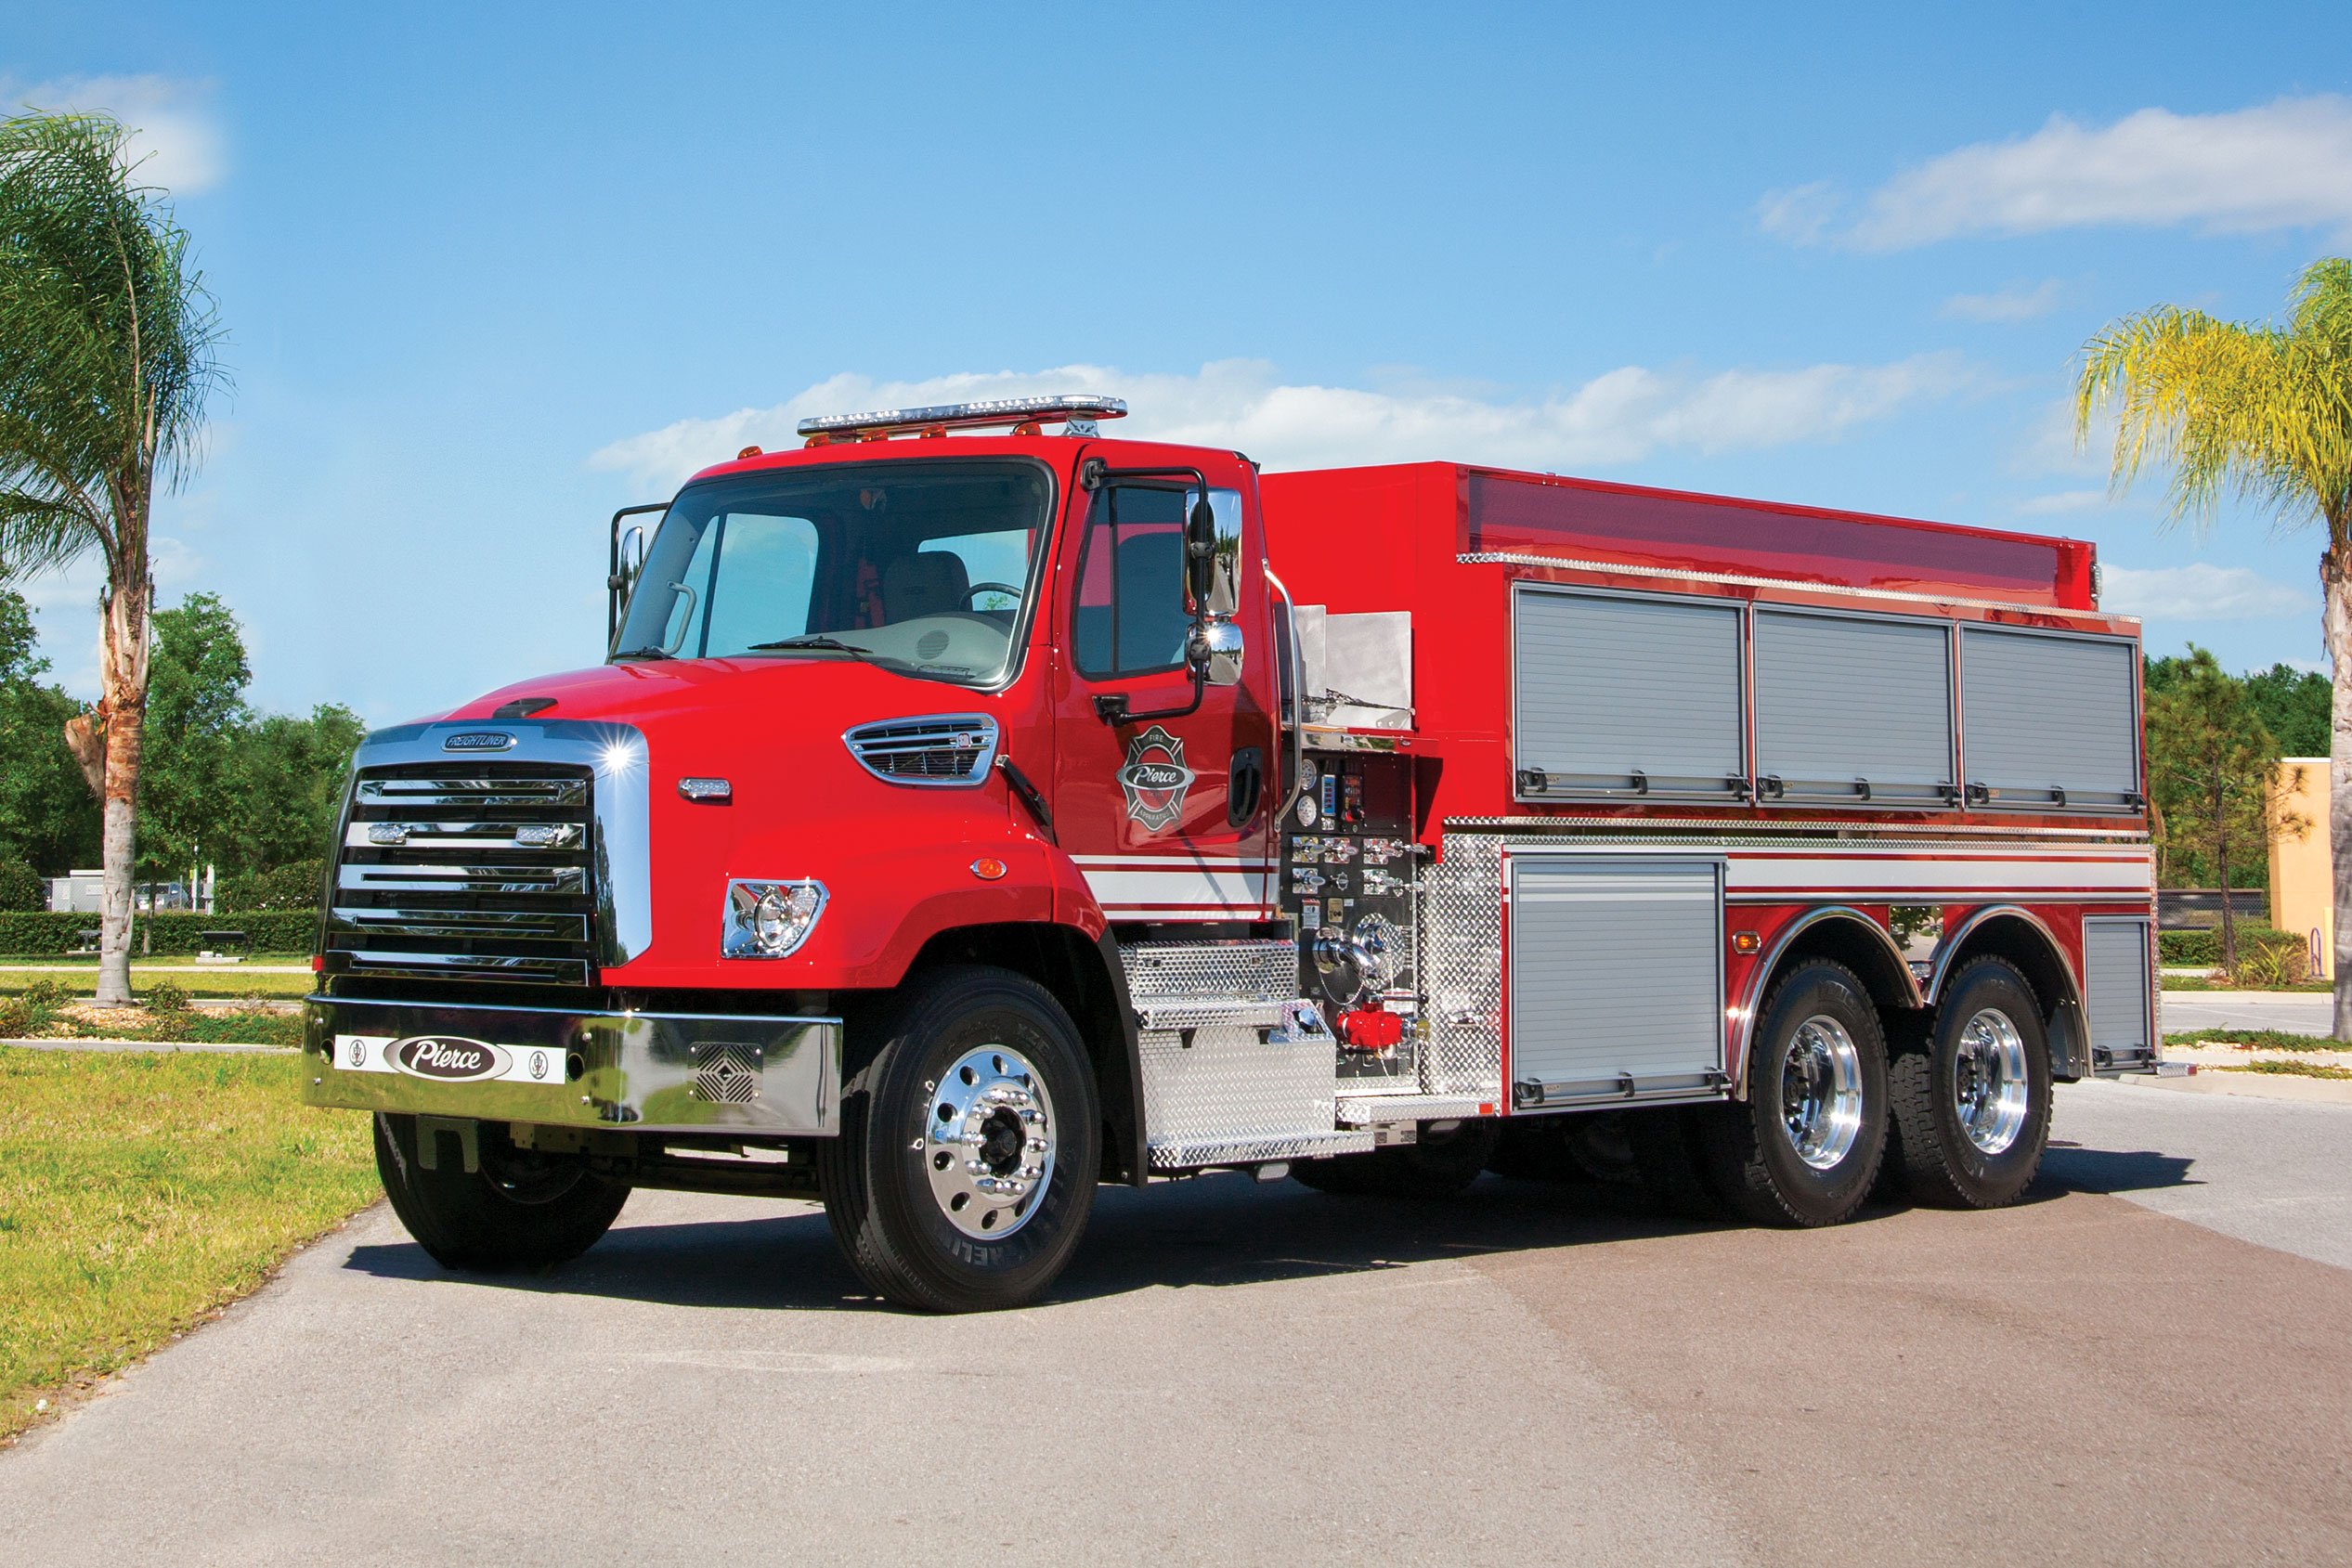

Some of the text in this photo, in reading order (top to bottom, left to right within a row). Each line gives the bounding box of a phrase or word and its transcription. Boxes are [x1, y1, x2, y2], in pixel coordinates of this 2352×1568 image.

[448, 735, 506, 746] FREIGHTLINER
[1149, 734, 1163, 743] FIRE
[1134, 767, 1176, 784] Pierce
[411, 1041, 481, 1069] Pierce
